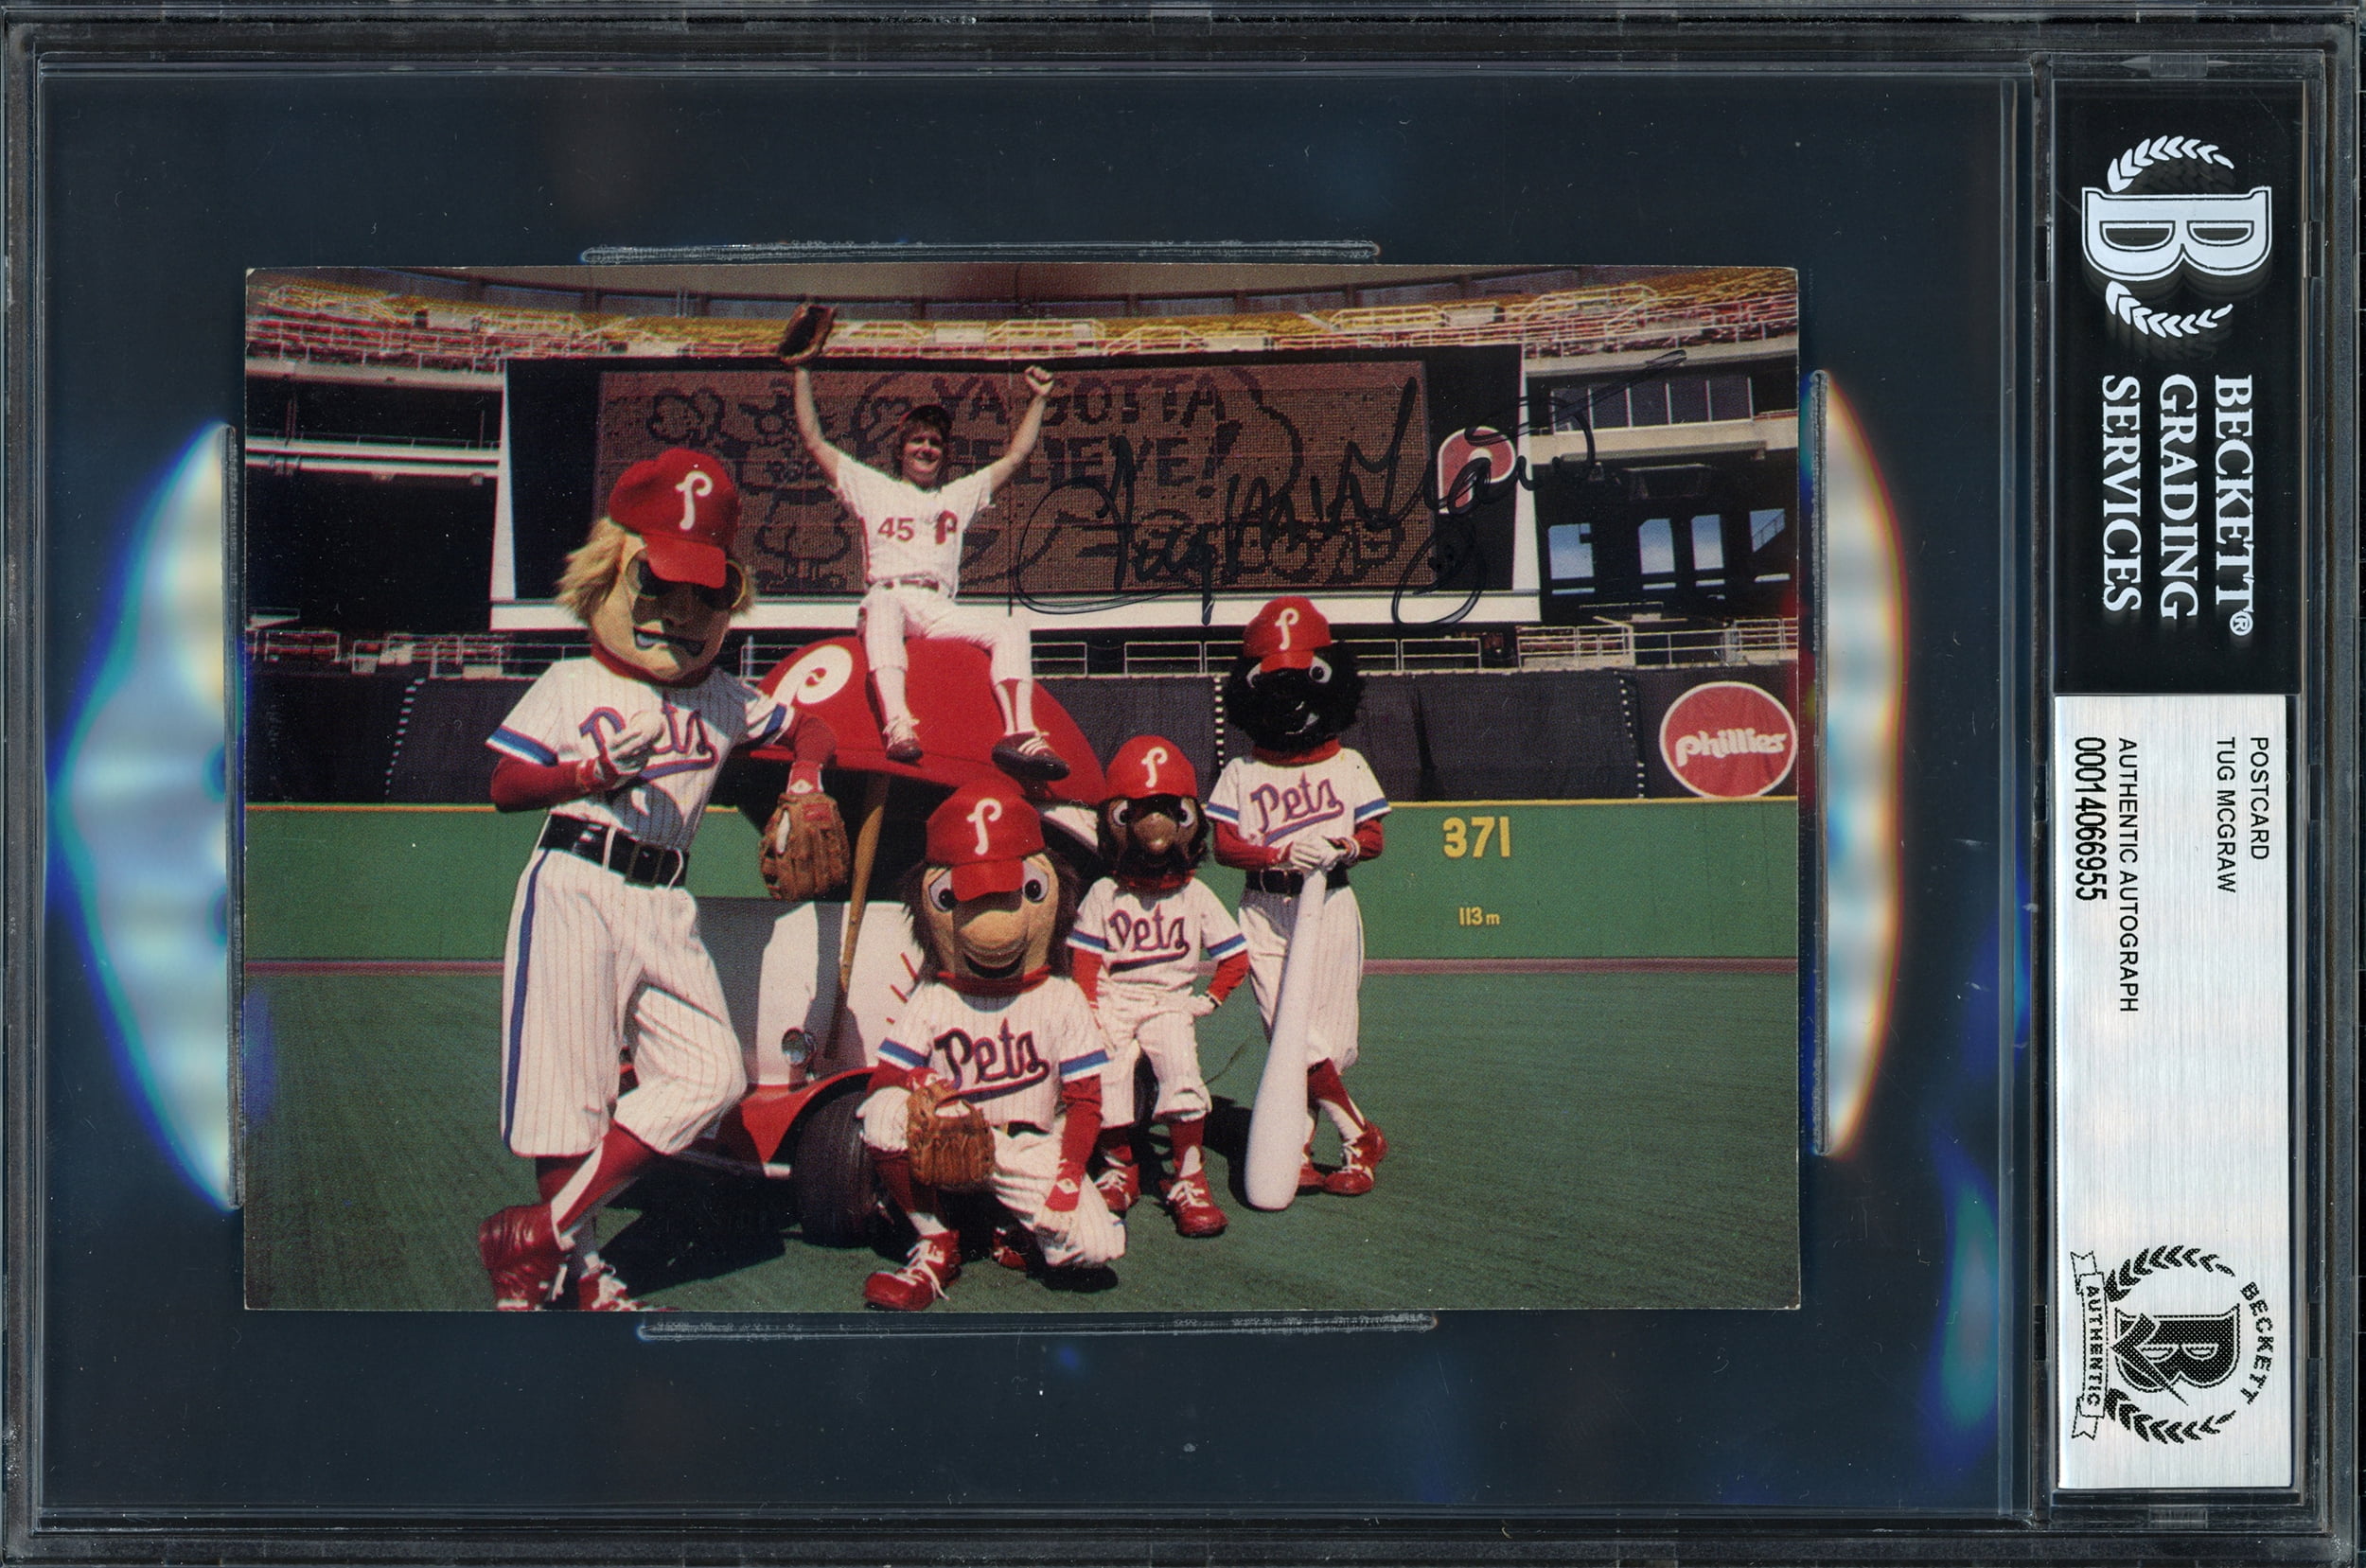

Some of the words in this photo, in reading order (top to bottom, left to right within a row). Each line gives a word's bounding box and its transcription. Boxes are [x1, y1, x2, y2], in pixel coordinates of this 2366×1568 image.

[675, 471, 713, 531] P
[878, 518, 915, 542] 45
[935, 510, 958, 545] P
[2102, 375, 2142, 611] SERVICES
[2159, 374, 2198, 621] GRADING
[1275, 608, 1299, 651] P
[1141, 747, 1168, 788] P
[2216, 735, 2236, 782] TUG
[2250, 736, 2269, 860] POSTCARD
[966, 797, 1003, 855] P
[1249, 771, 1345, 844] Pets
[1443, 816, 1511, 857] 371
[2075, 736, 2108, 900] 00014066955
[2118, 738, 2139, 863] AUTHENTIC
[2216, 789, 2237, 892] MCGRAW
[1108, 904, 1190, 973] Pets
[2118, 871, 2140, 1012] AUTOGRAPH
[934, 1017, 1051, 1103] Pets
[2085, 1284, 2104, 1407] AUTHENTIC
[2239, 1280, 2274, 1406] BECKETT
